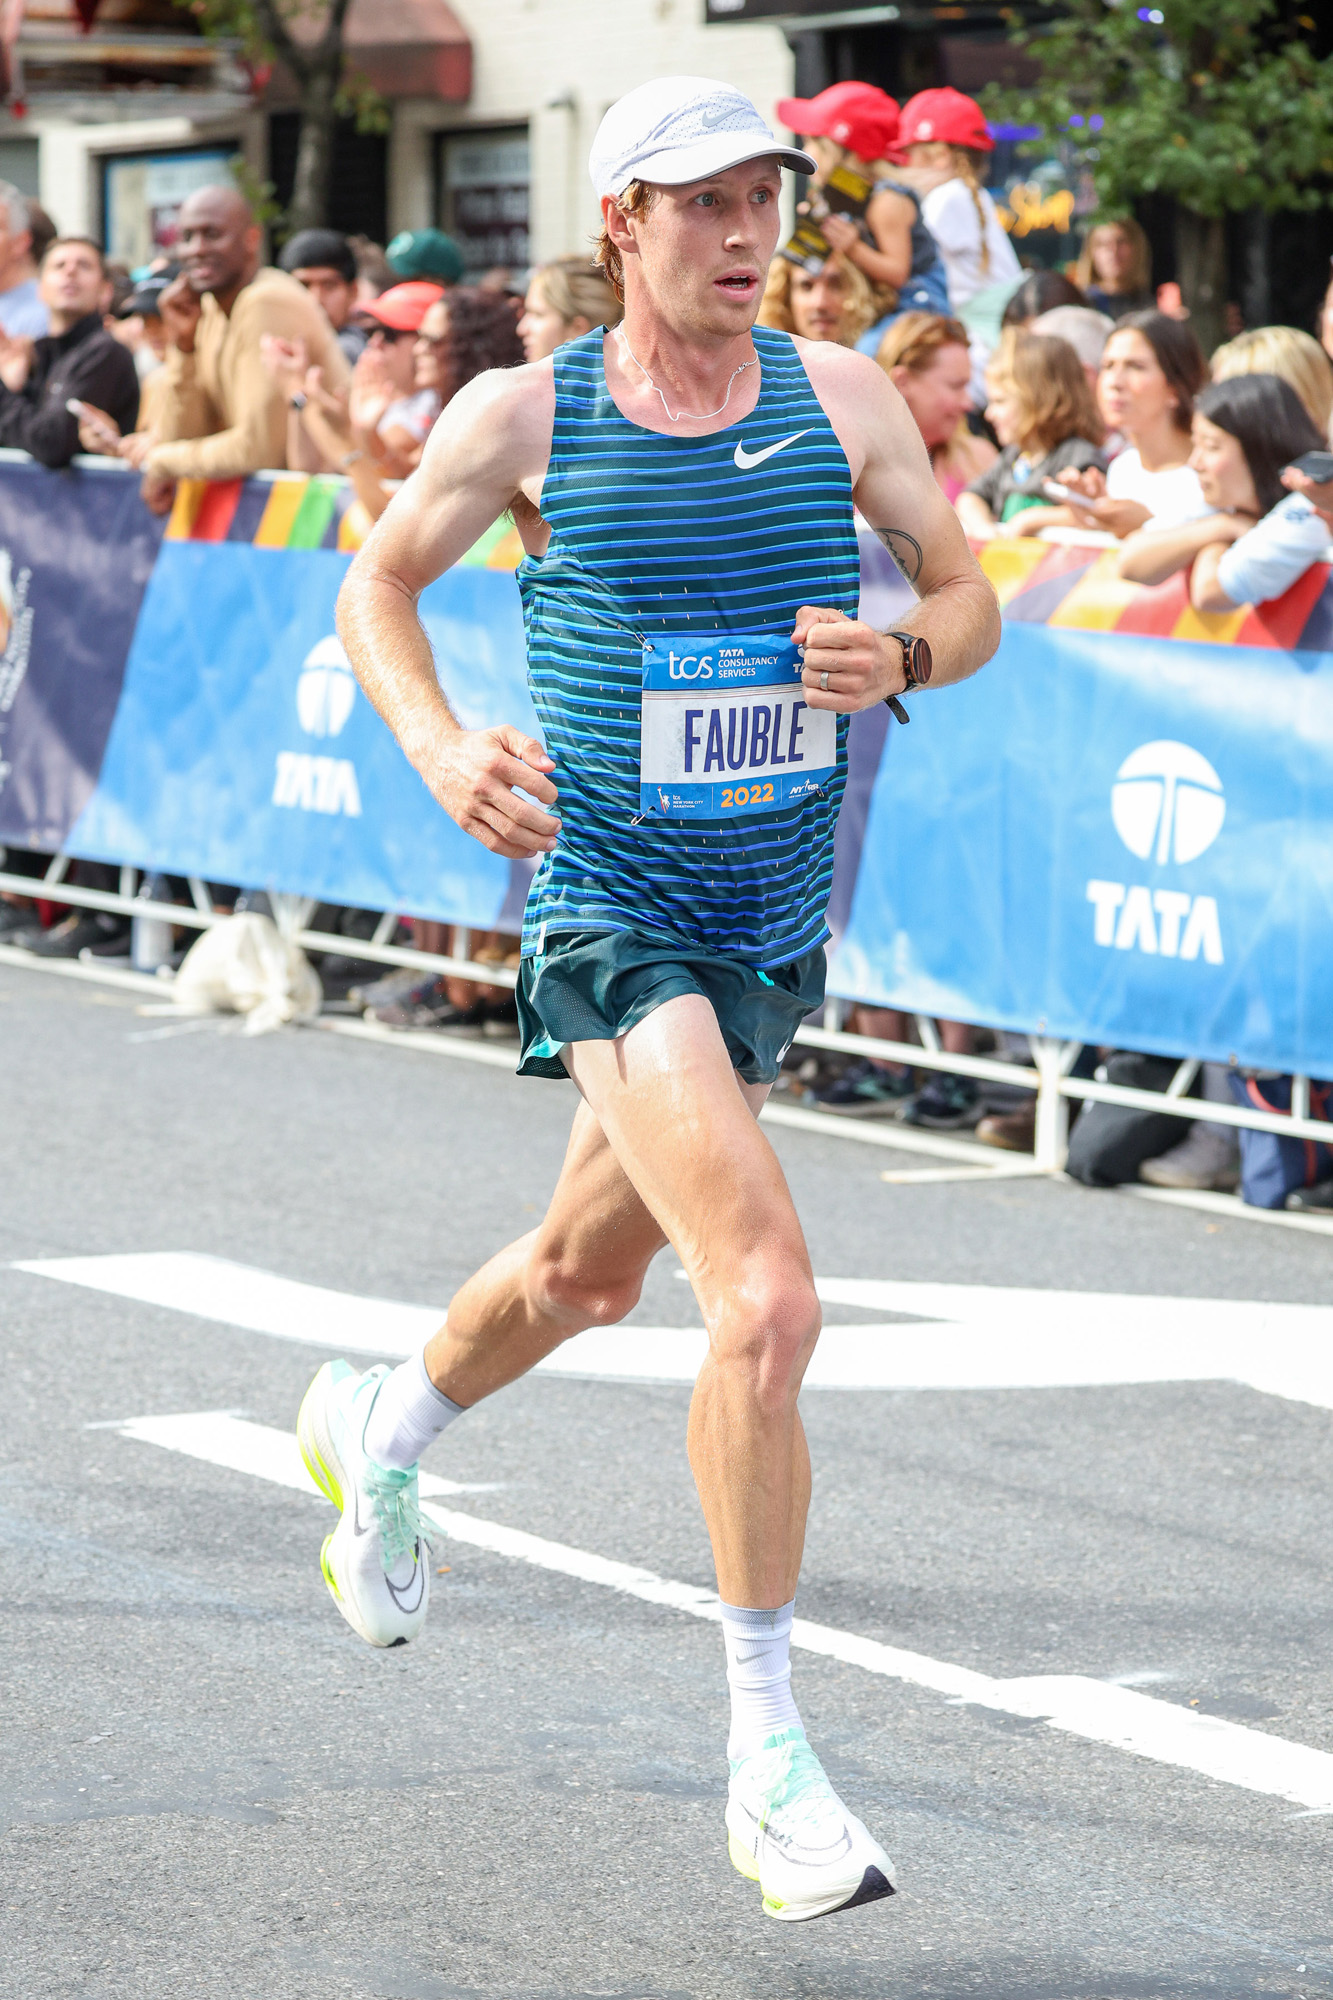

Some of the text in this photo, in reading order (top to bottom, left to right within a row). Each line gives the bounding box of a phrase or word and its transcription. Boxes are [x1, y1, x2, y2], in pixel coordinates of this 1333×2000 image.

[669, 650, 714, 680] tcs
[718, 648, 744, 658] TATA
[718, 656, 778, 668] CONSULTANCY
[718, 668, 756, 678] SERVICES
[684, 700, 808, 773] FAUBLE
[271, 750, 363, 818] TATA
[720, 783, 775, 808] 2022
[1086, 879, 1224, 966] TATA
